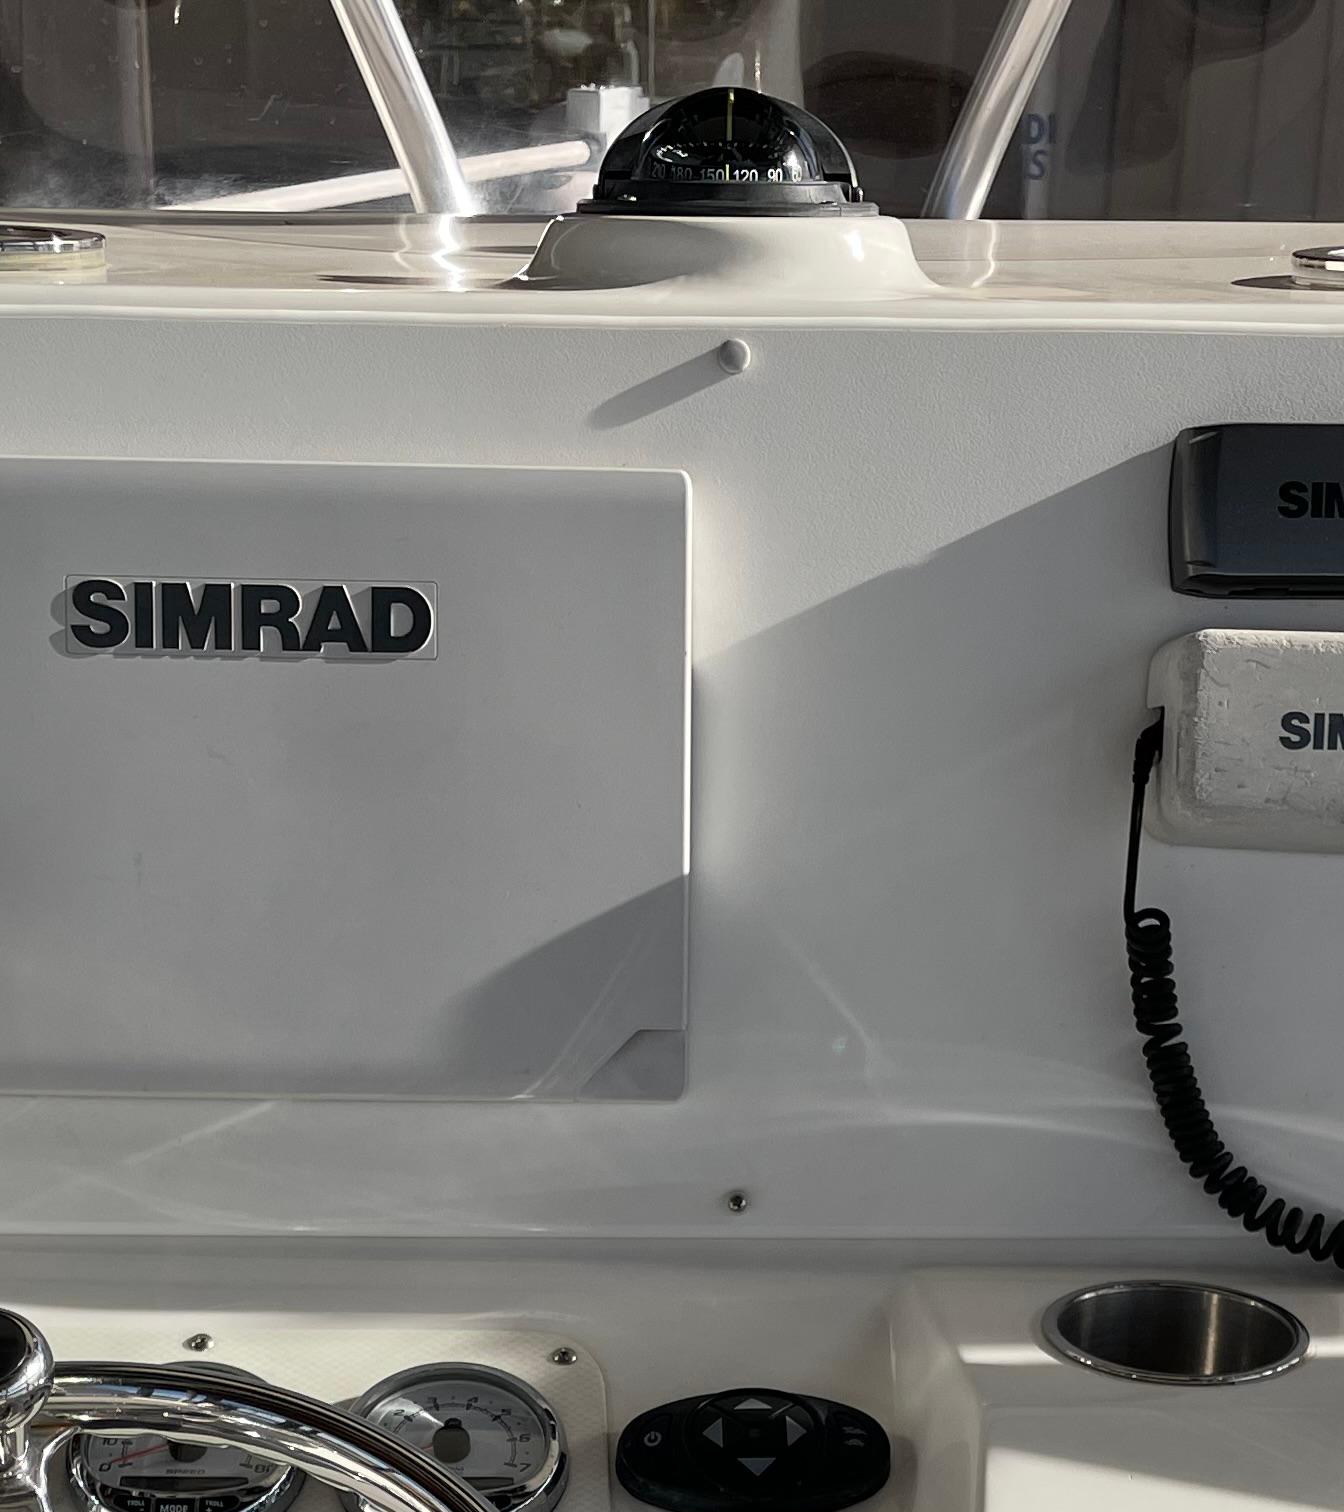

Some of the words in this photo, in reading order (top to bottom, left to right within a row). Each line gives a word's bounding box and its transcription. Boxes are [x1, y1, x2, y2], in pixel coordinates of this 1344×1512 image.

[700, 168, 725, 181] 150
[733, 168, 758, 181] 120
[767, 168, 783, 182] 90
[70, 579, 433, 653] SIMRAD
